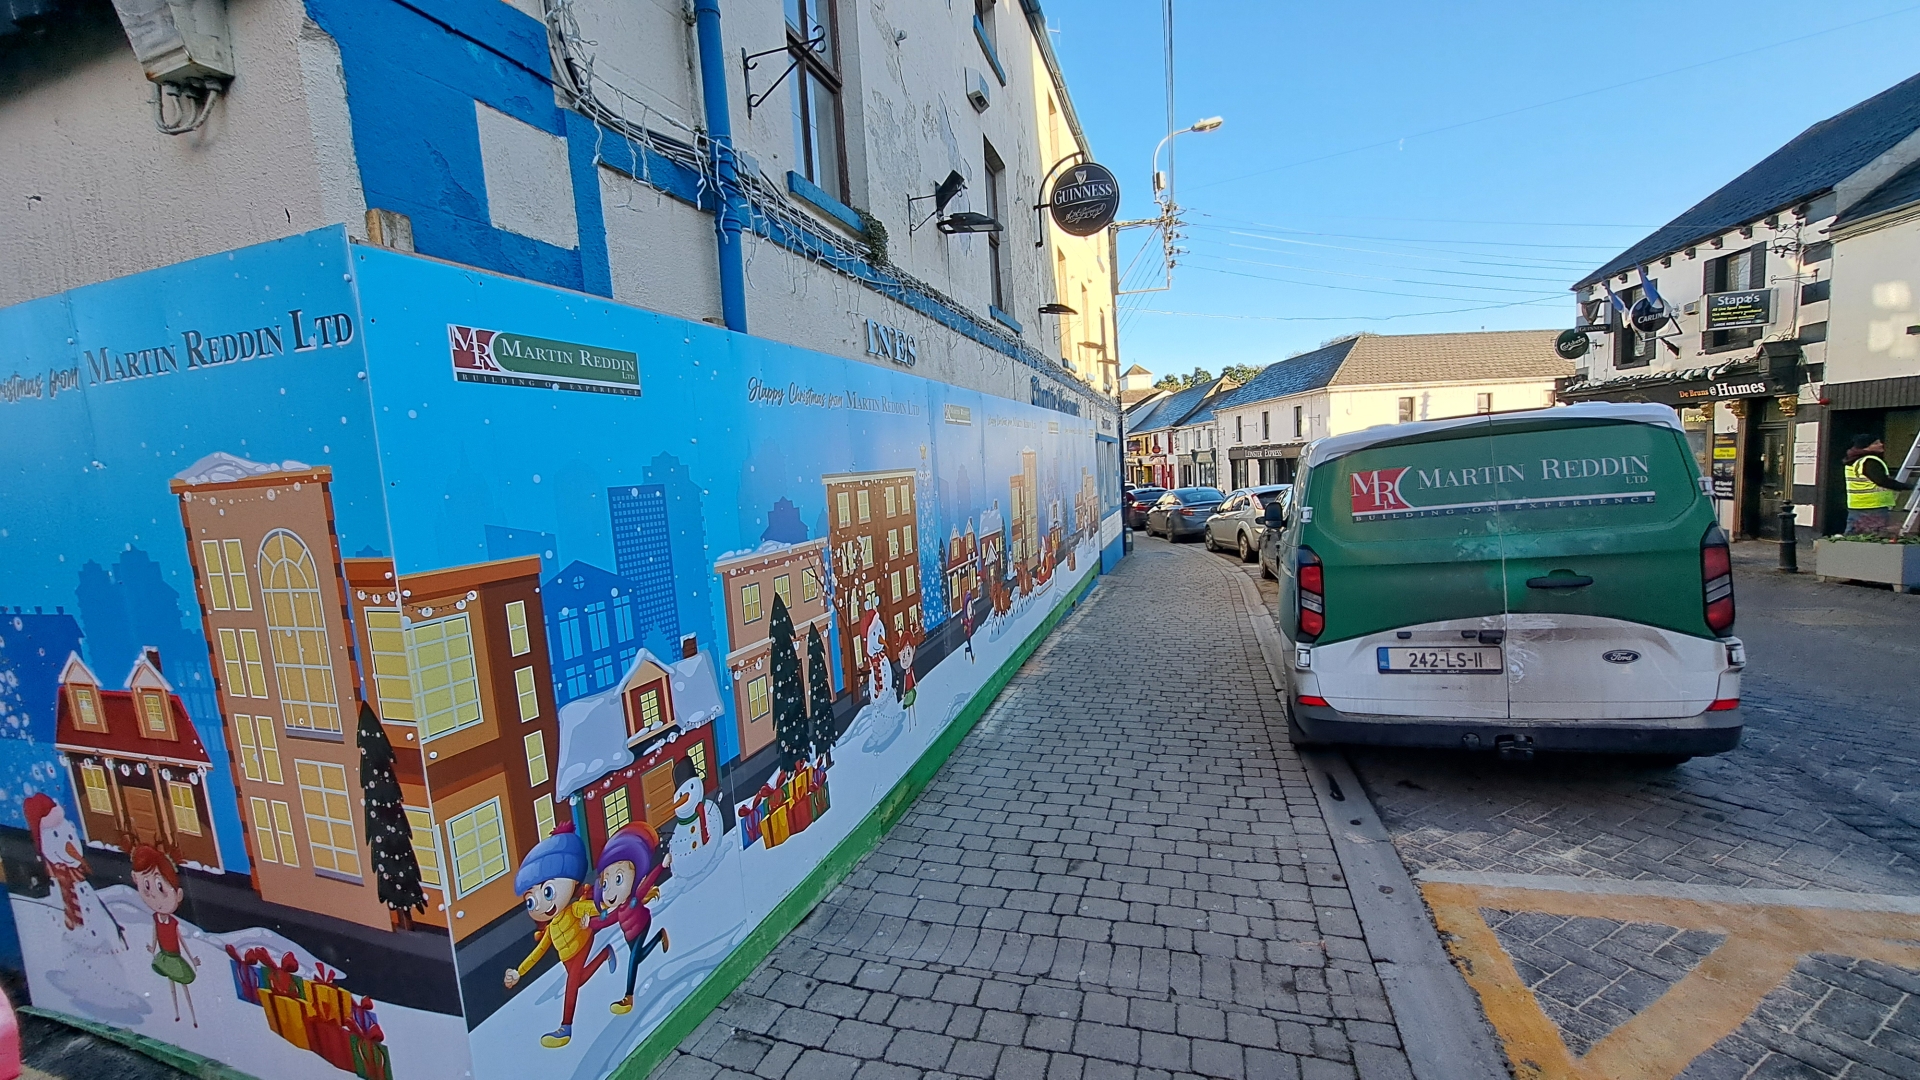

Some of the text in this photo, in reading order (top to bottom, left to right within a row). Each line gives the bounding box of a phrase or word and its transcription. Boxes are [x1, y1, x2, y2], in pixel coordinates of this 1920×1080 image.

[1054, 183, 1113, 205] GUINNESS
[1638, 313, 1663, 324] CARLIN
[500, 337, 634, 372] MARTIN REDDIN
[1560, 335, 1586, 352] Carlsberg
[50, 367, 80, 398] from
[84, 345, 178, 385] MARTIN
[181, 325, 284, 371] REDDIN
[462, 373, 535, 387] BUILDING
[569, 384, 639, 396] EXPERIENCE
[748, 376, 785, 406] Happy
[789, 382, 826, 408] Christmas
[828, 391, 844, 409] from
[1679, 390, 1689, 398] De
[1716, 382, 1766, 397] Humes
[1417, 454, 1649, 490] MARTIN REDDIN
[1626, 475, 1648, 485] LTD
[1355, 508, 1455, 522] BUILDING
[1515, 496, 1654, 510] EXPERIENCE
[1610, 652, 1633, 661] Ford
